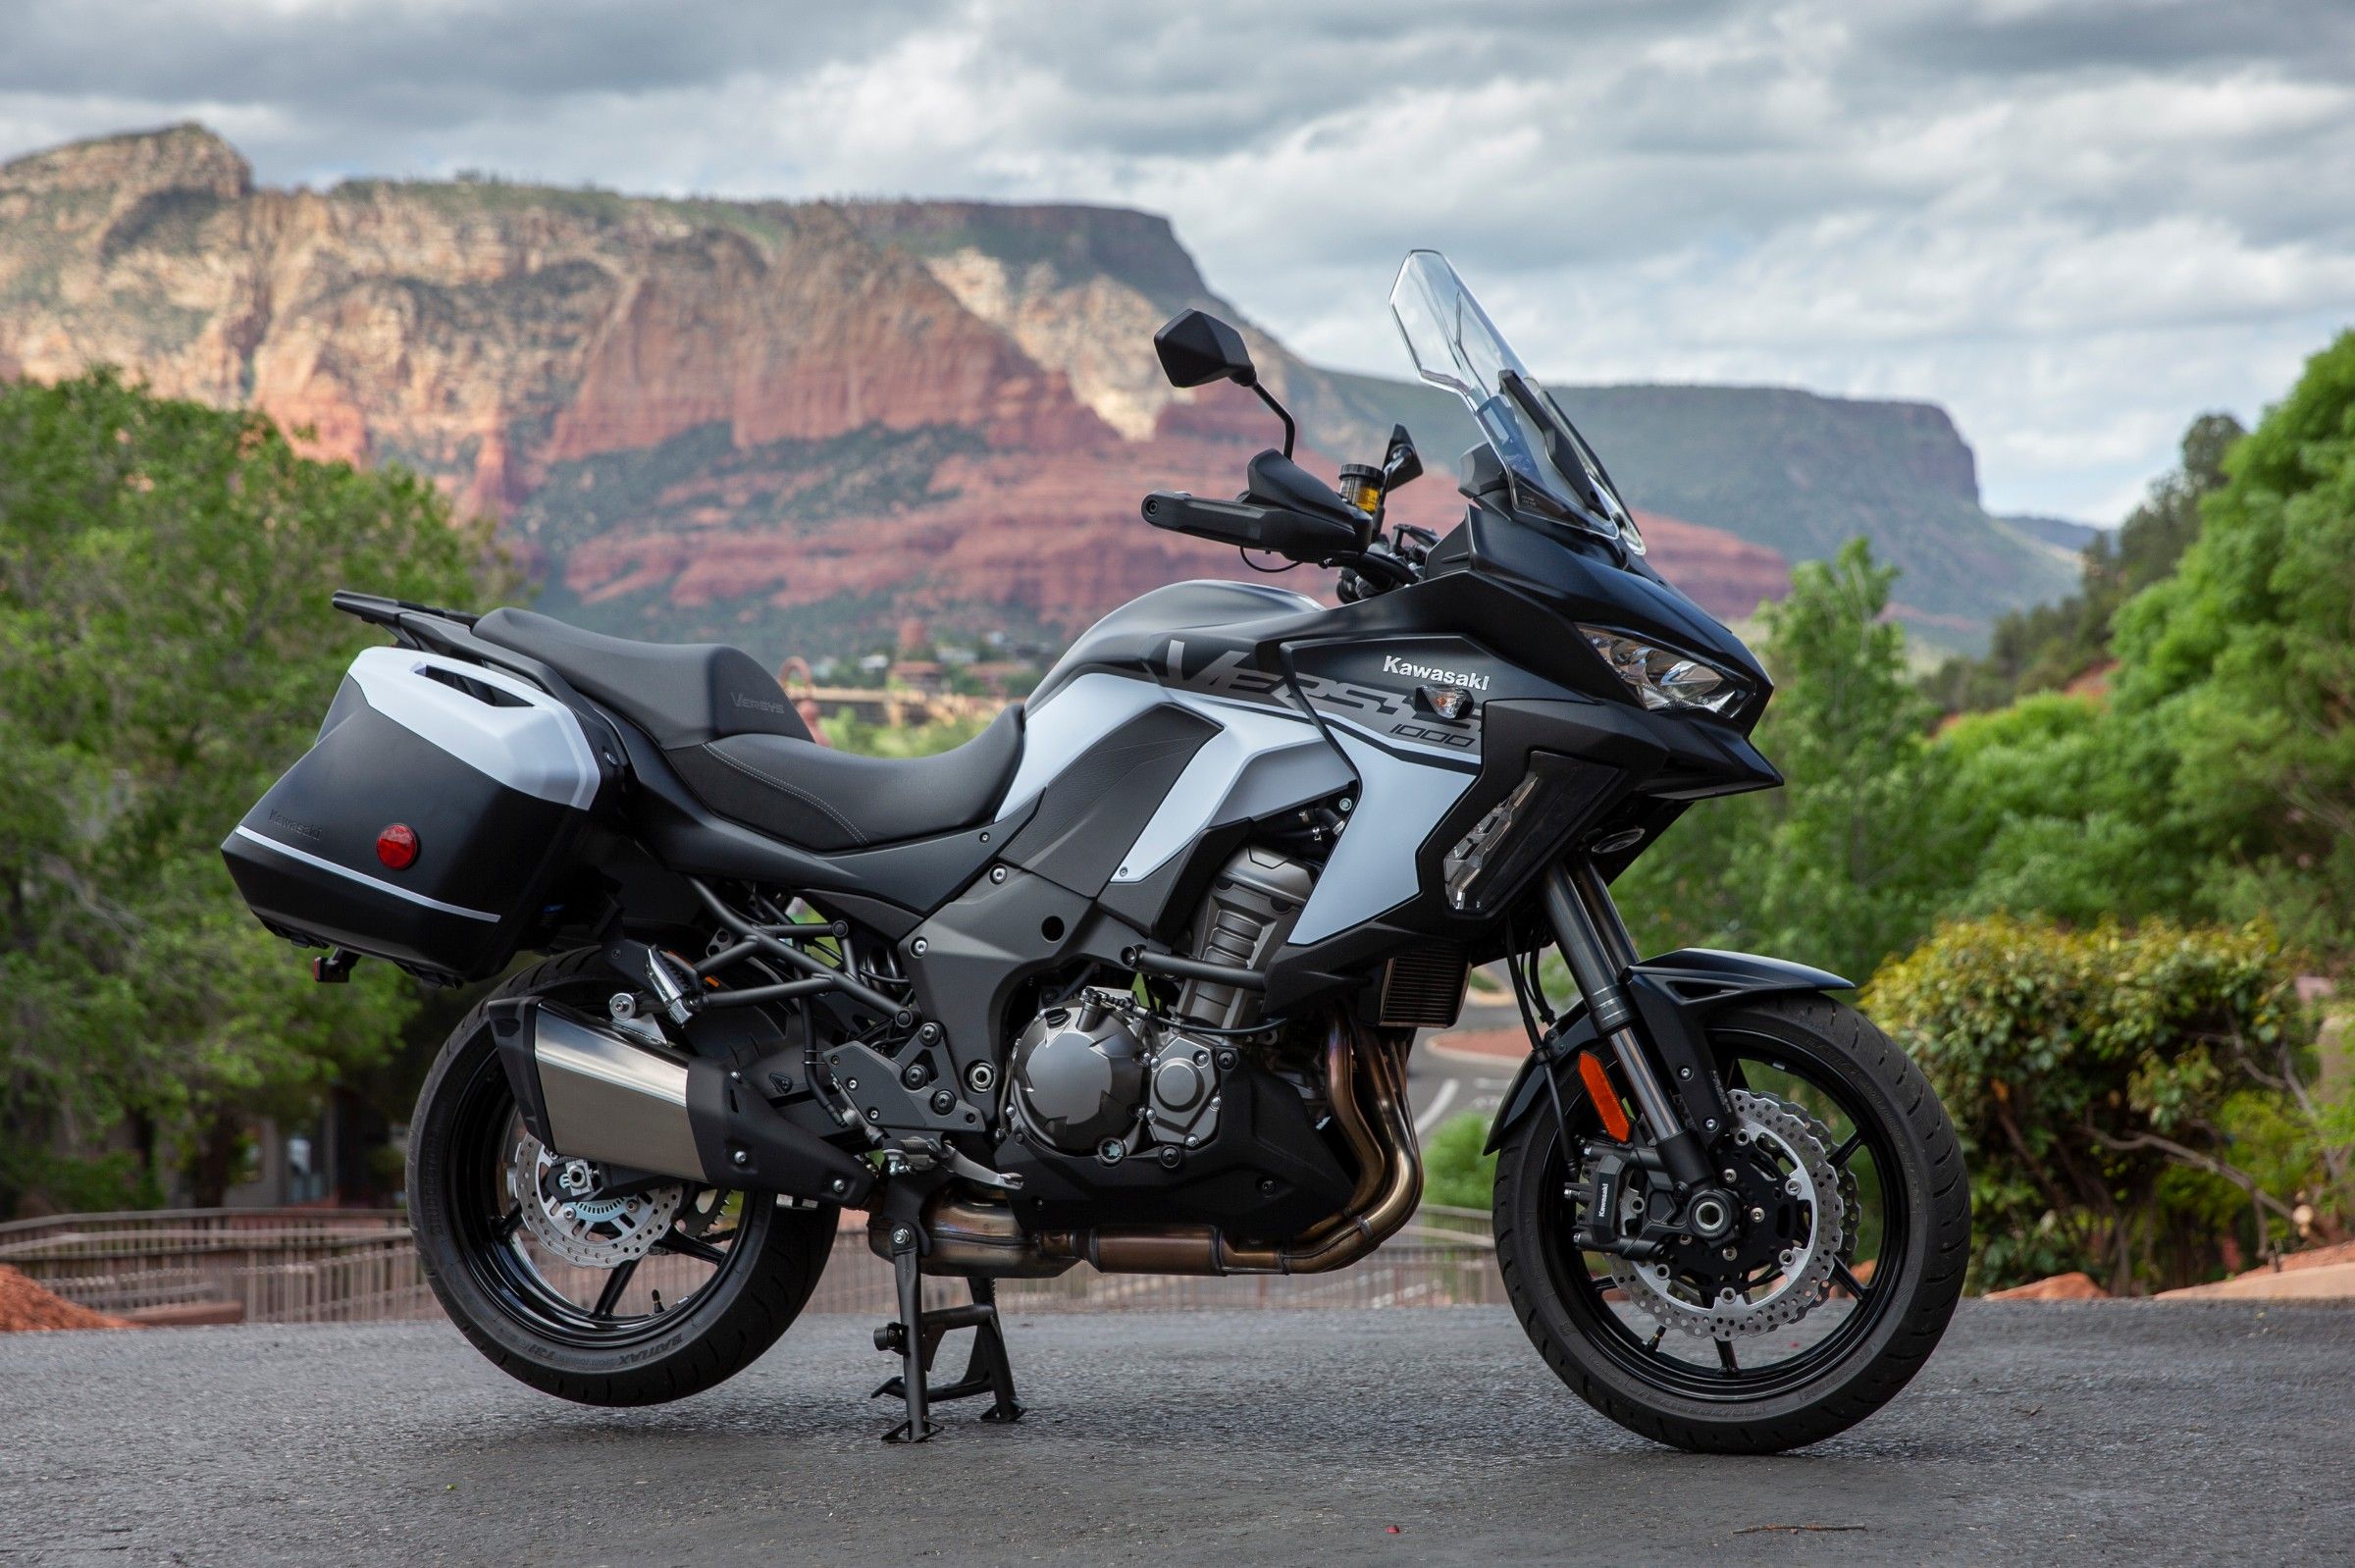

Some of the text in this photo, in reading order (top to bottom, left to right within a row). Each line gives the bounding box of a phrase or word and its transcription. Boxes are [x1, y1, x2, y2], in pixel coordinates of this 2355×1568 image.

[1383, 654, 1491, 691] Kawasaki
[730, 690, 785, 714] VERSYS
[1389, 723, 1477, 748] 1000
[268, 808, 322, 841] Kawasaki
[1597, 1183, 1609, 1218] Kawasaki
